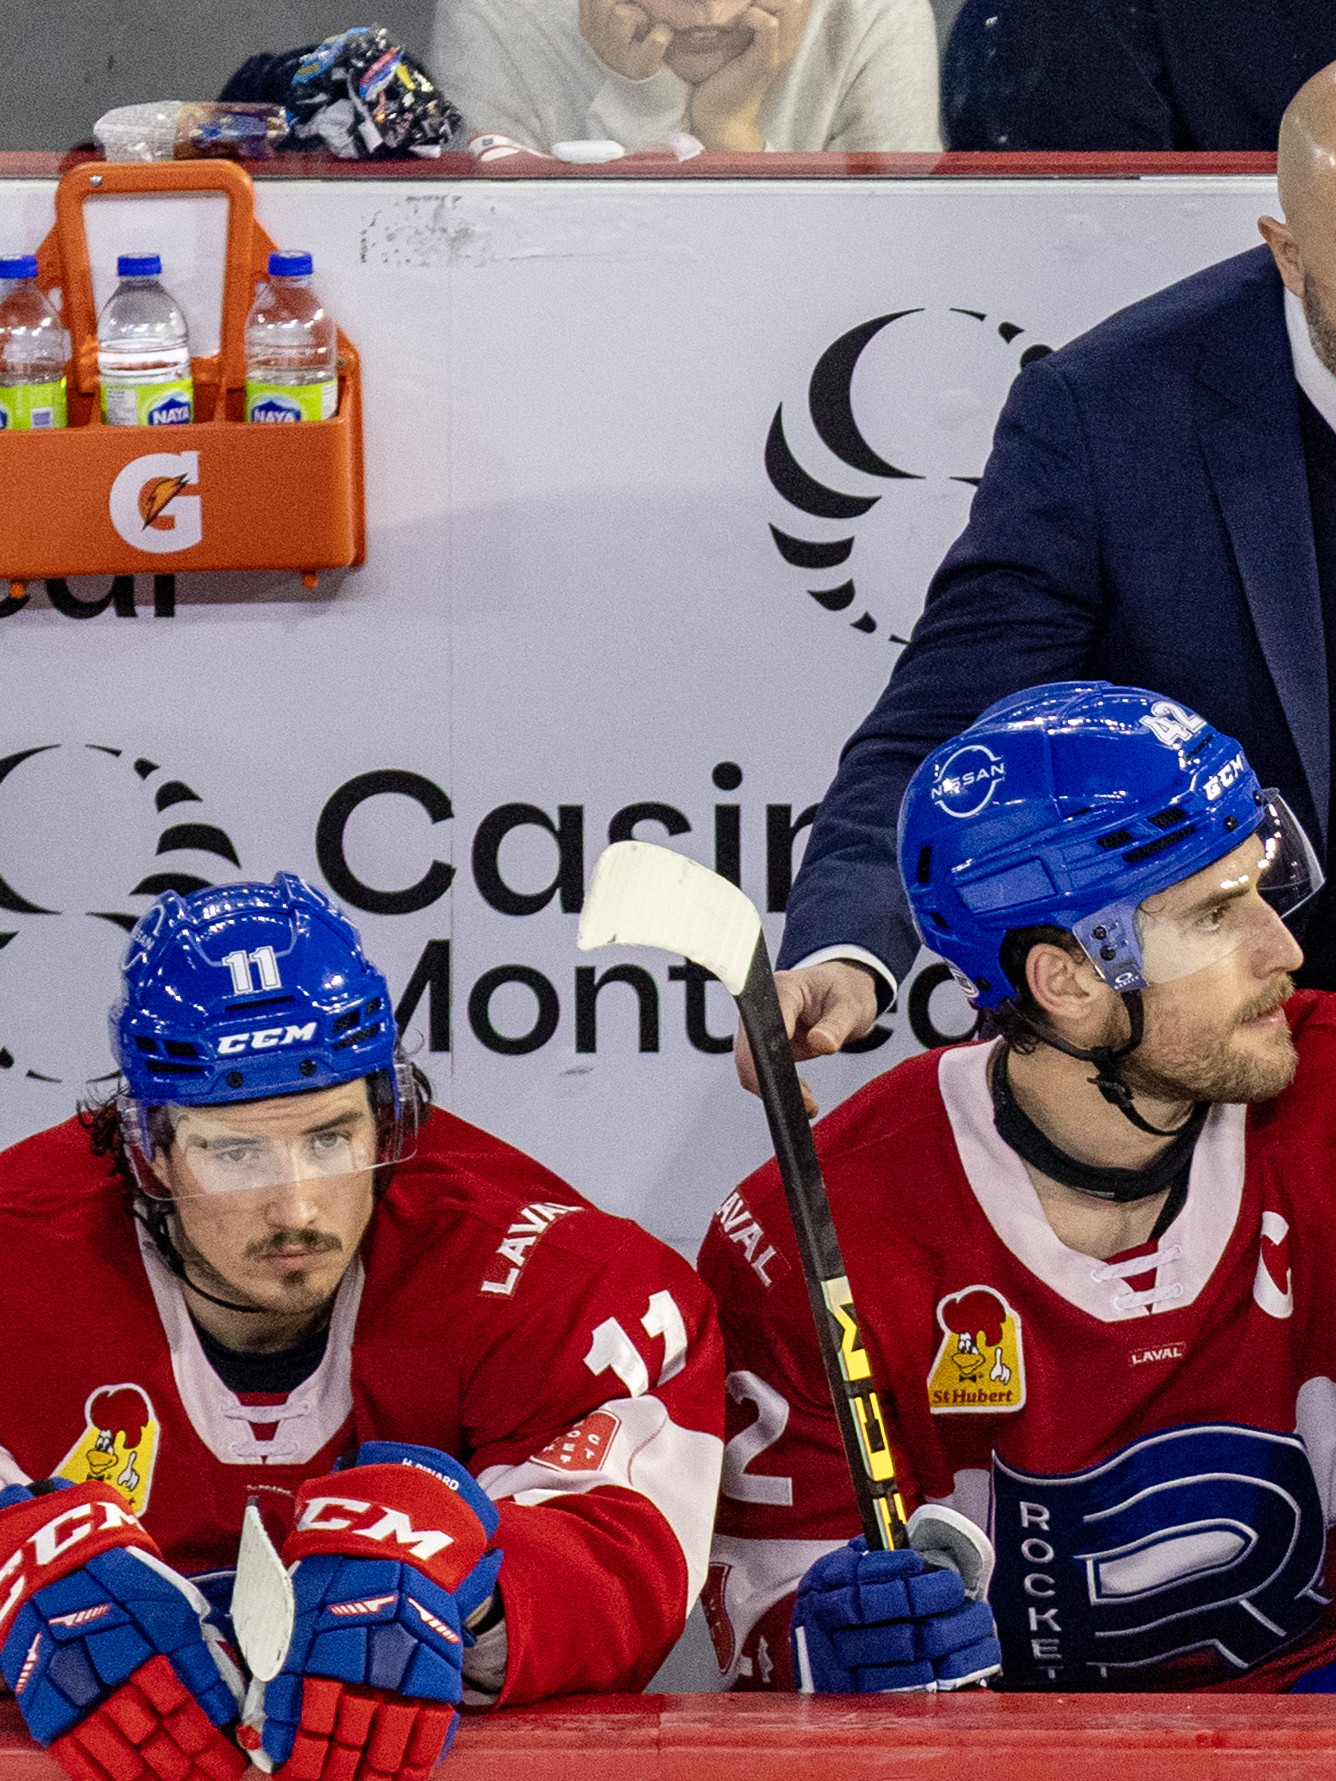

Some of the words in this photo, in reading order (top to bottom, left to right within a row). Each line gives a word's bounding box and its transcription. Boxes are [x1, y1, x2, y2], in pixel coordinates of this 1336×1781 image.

[152, 405, 190, 425] NAYA
[1140, 701, 1207, 745] 42
[1203, 754, 1245, 801] CCM
[222, 945, 282, 995] 11
[216, 1022, 318, 1055] CCM
[715, 1192, 777, 1288] AVAL
[582, 1289, 688, 1399] 11
[1131, 1347, 1183, 1365] LAVAL
[932, 1388, 950, 1404] St
[953, 1387, 1014, 1403] Hubert
[722, 1370, 793, 1508] 2
[297, 1497, 454, 1561] CM
[1018, 1501, 1065, 1680] ROCKET
